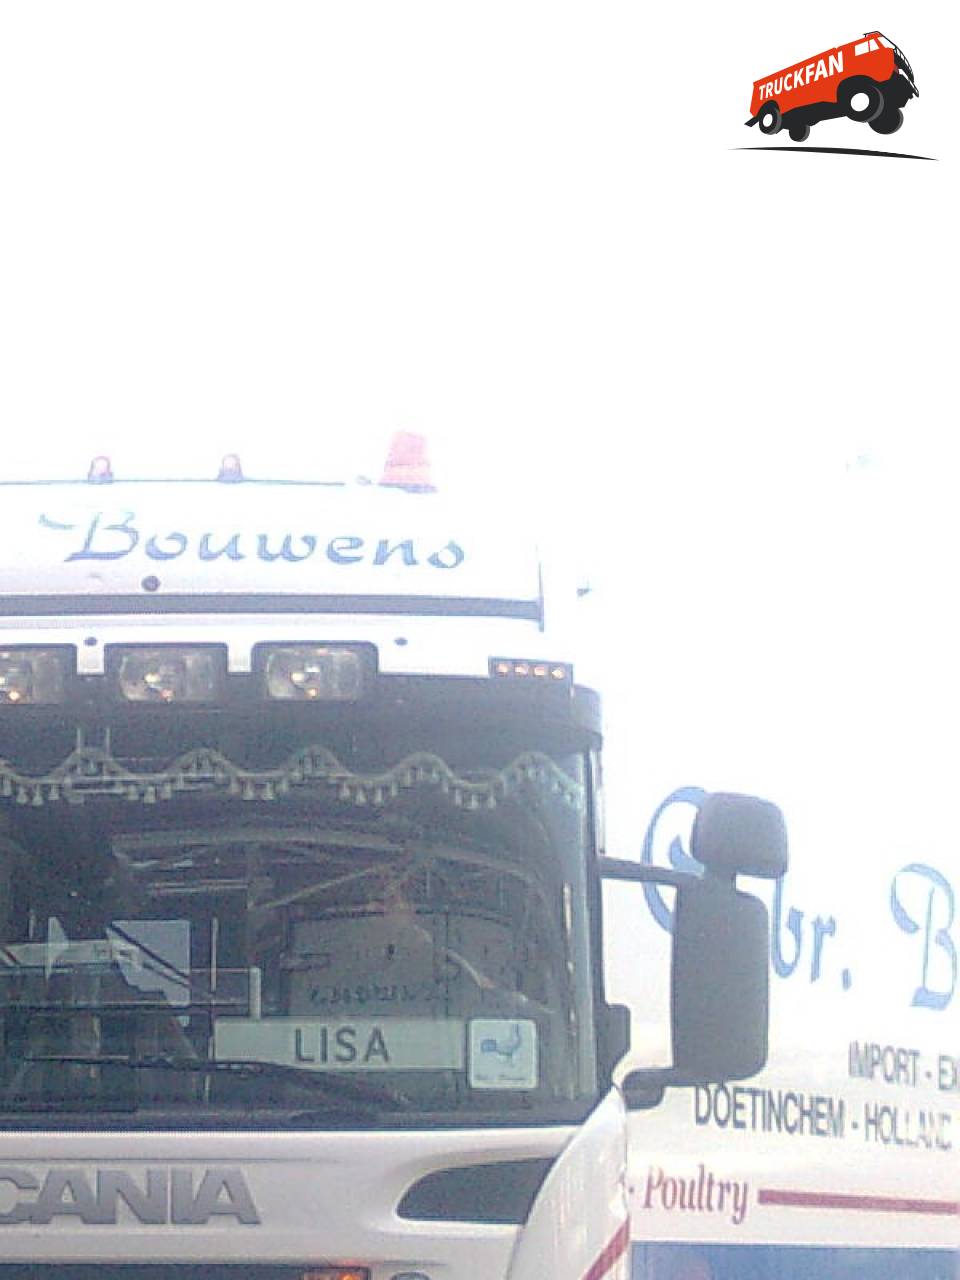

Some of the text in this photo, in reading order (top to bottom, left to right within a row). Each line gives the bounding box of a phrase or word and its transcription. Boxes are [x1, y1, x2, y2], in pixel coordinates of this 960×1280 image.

[39, 510, 467, 570] Bouwens
[293, 1026, 390, 1064] LISA
[695, 1084, 844, 1139] DOETINCHEM
[643, 1163, 748, 1225] Poultry
